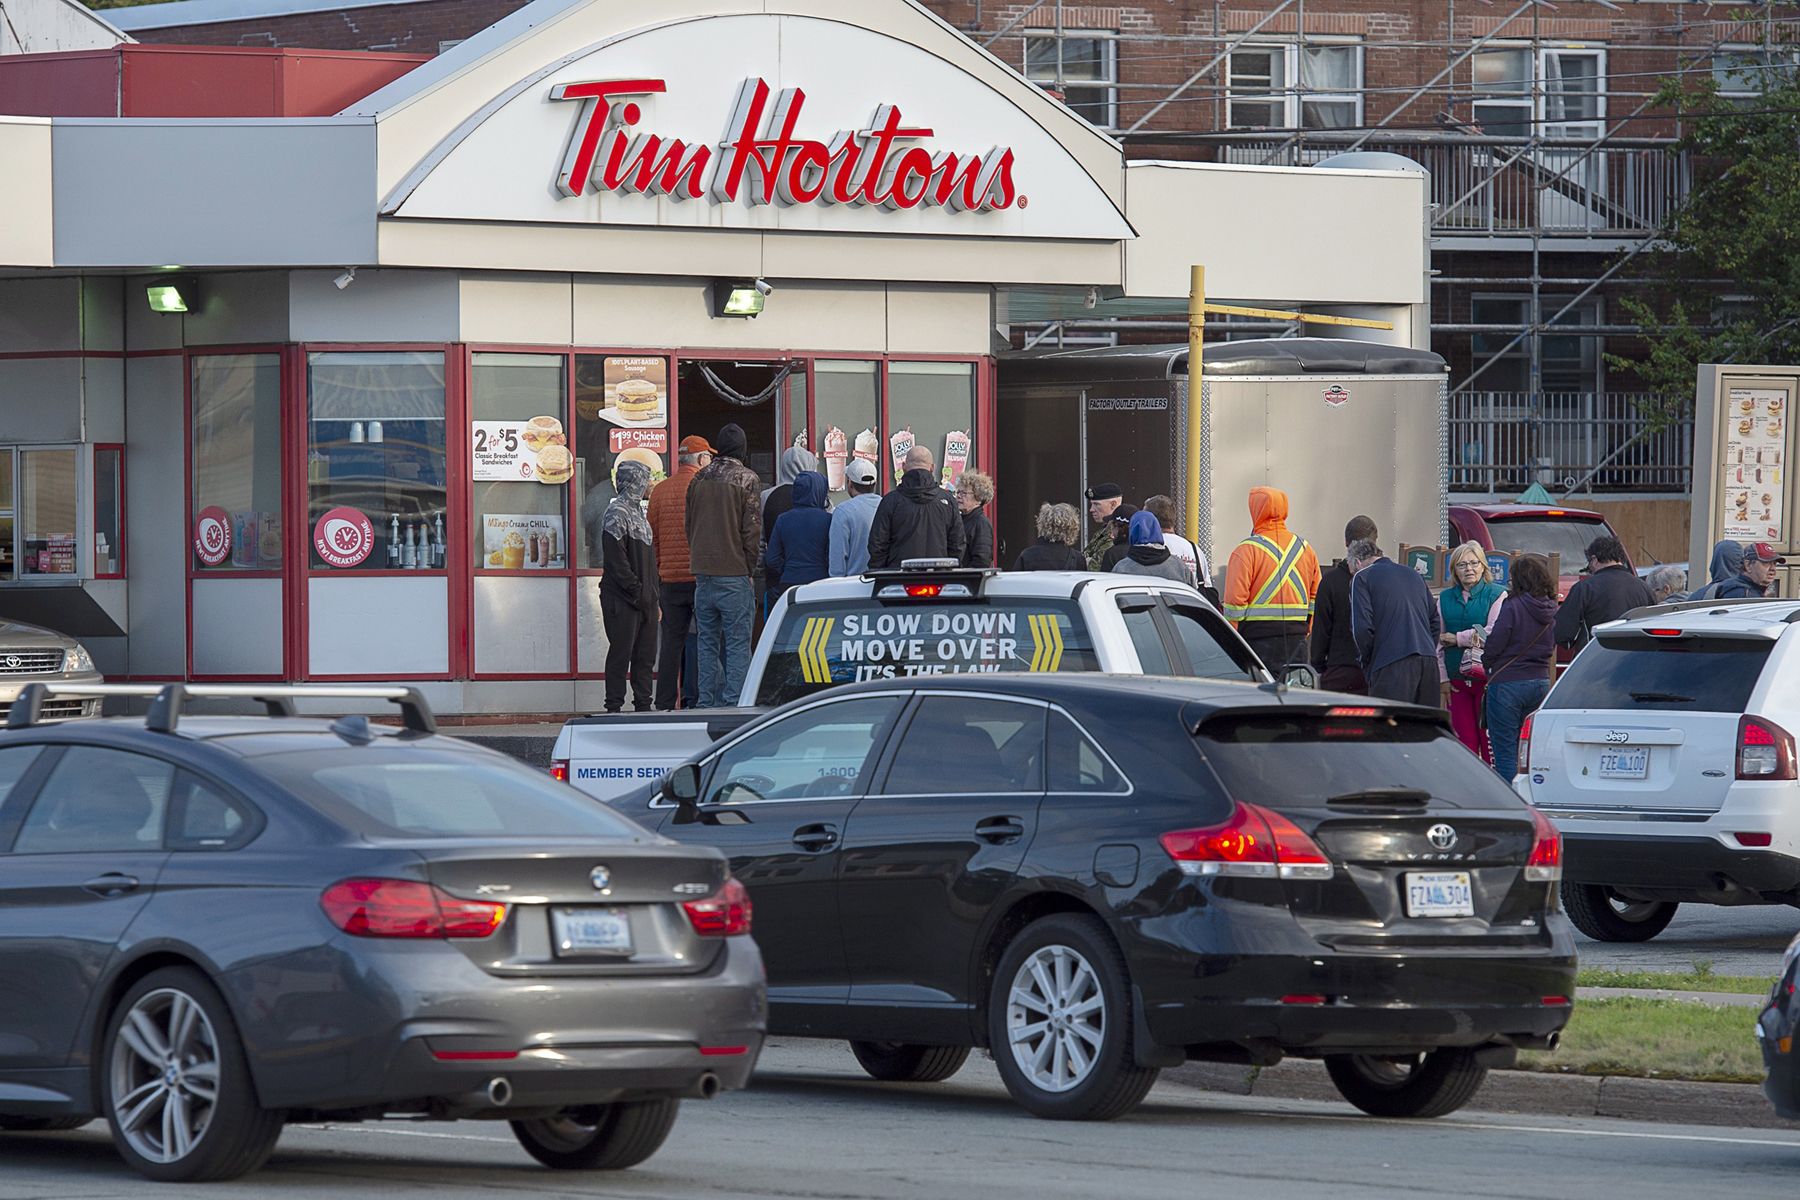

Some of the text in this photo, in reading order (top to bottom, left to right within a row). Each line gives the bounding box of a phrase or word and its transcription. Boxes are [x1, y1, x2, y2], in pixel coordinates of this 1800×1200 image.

[552, 76, 1016, 211] Tim Hortons
[624, 365, 646, 373] Sausage
[1089, 398, 1167, 410] FACTORY OUTLET TRAILERS
[474, 427, 519, 452] 2 for $5
[632, 431, 665, 441] Chicken
[894, 439, 912, 452] JOLLY
[947, 441, 966, 450] JOLLY
[493, 452, 518, 460] Breakfast
[529, 520, 550, 528] CHILL
[316, 539, 329, 558] NEW!
[328, 550, 365, 565] BREAKFAST
[842, 613, 1016, 636] SLOW DOWN
[841, 638, 1017, 661] MOVE OVER
[855, 665, 896, 683] IT'S
[1606, 730, 1629, 743] Jeep
[1600, 755, 1646, 771] FZE 100
[577, 768, 633, 778] MEMBER
[1407, 853, 1477, 861] VENZA
[1446, 886, 1470, 905] 304
